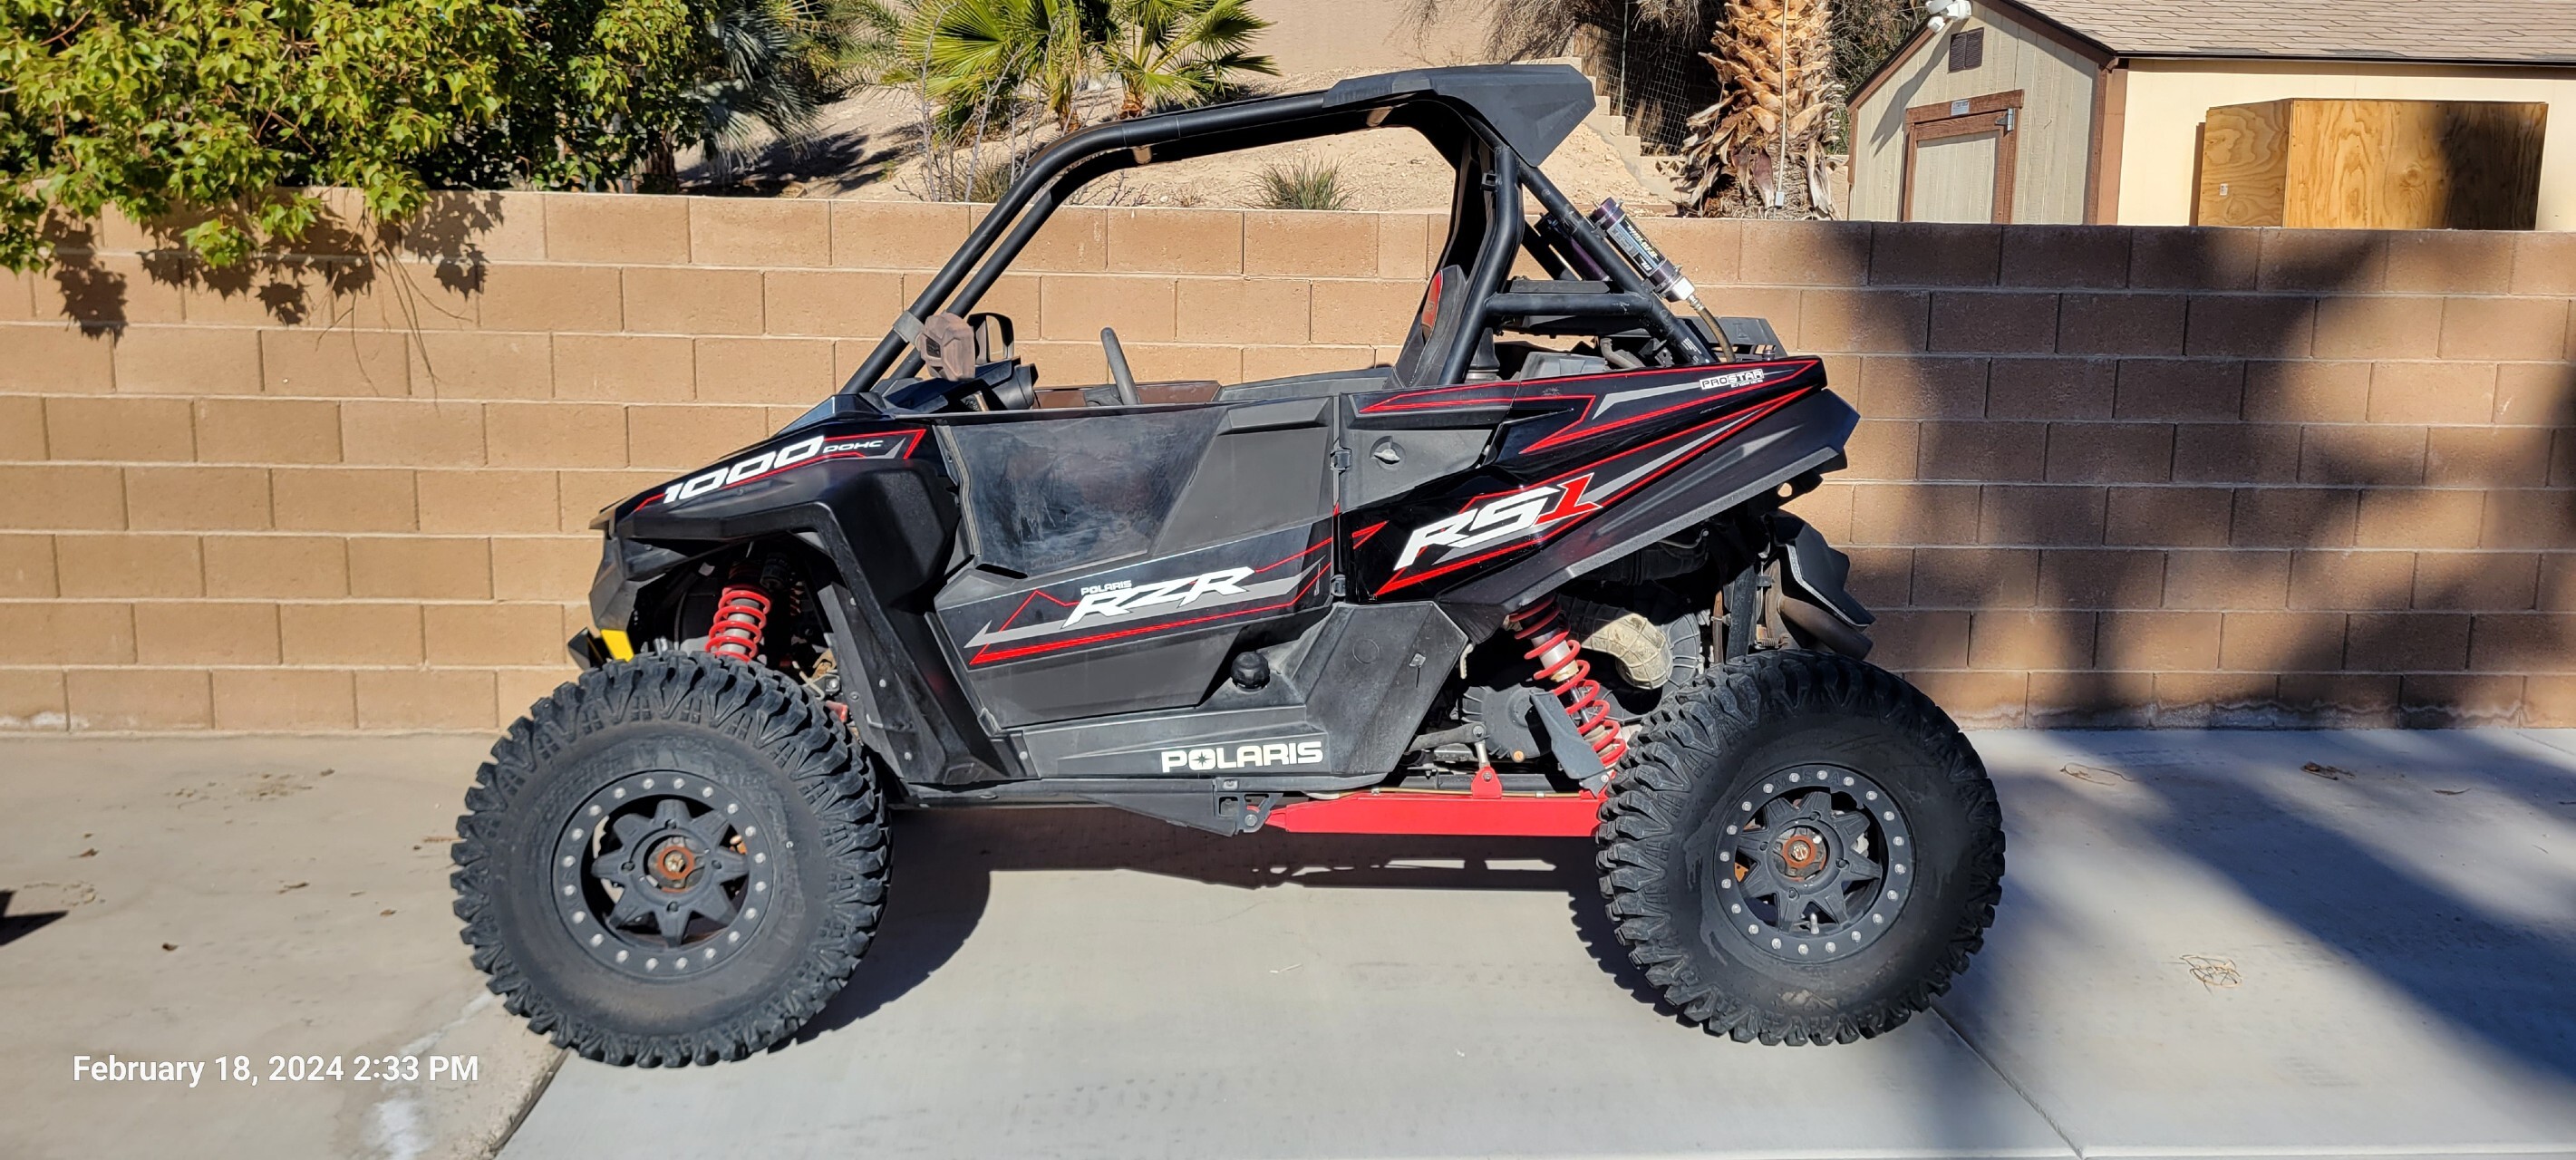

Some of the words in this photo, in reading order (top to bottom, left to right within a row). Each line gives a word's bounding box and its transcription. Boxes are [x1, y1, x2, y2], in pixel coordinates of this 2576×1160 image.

[1700, 370, 1764, 390] PROSTAR
[663, 435, 825, 504] 1000
[823, 440, 884, 454] DOHC
[1393, 471, 1603, 571] RS1
[1060, 566, 1255, 630] RZR
[1080, 579, 1132, 596] POLARIS
[1161, 740, 1323, 773] POLARIS
